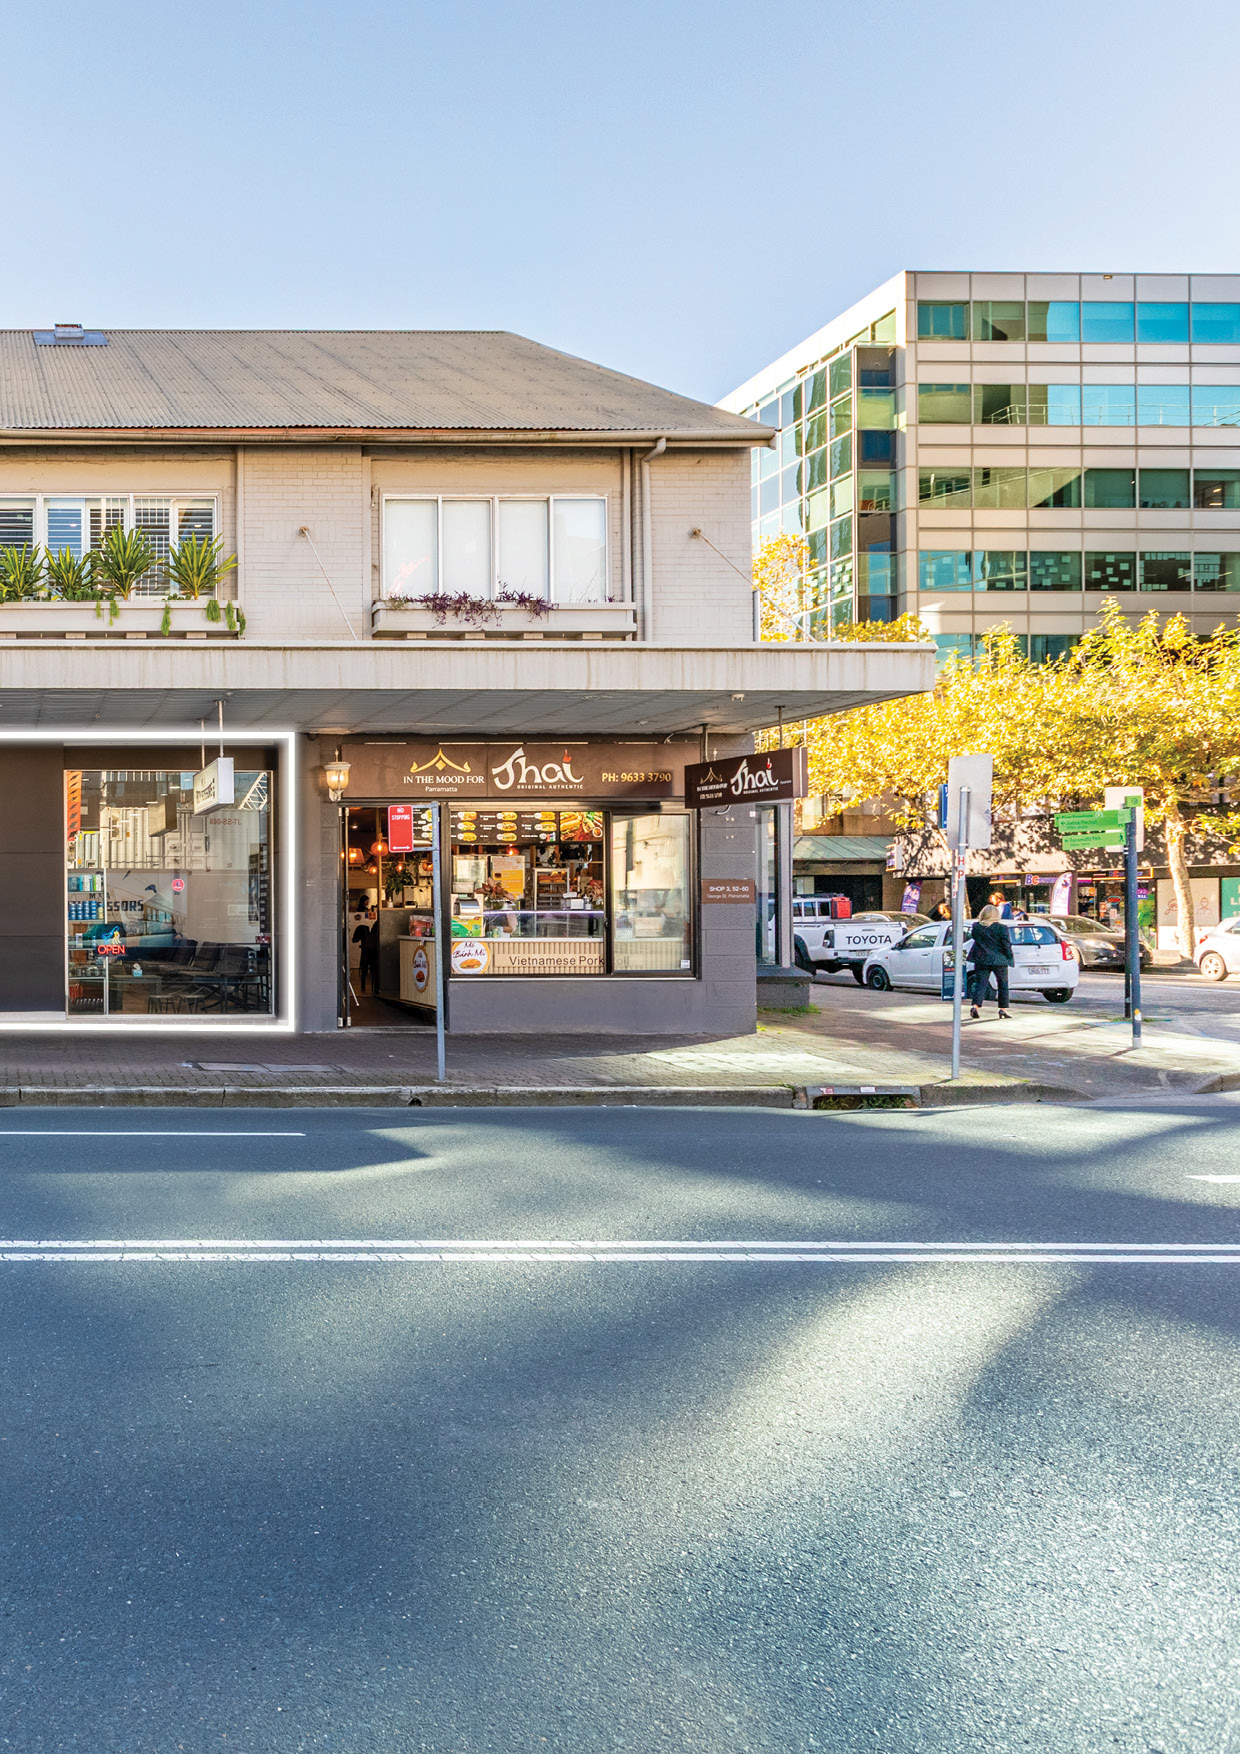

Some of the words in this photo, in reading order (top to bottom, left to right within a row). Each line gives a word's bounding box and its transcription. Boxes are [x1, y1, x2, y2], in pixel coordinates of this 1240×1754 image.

[492, 747, 584, 790] Thai
[602, 773, 619, 782] PH:
[621, 773, 645, 782] 9633
[648, 773, 671, 782] 3790
[731, 759, 778, 795] Thai
[1025, 874, 1039, 885] BC
[107, 900, 144, 911] SSORS
[846, 935, 892, 945] TOYOTA
[98, 945, 126, 954] OPEN
[509, 956, 576, 966] Vietnamese
[579, 956, 604, 966] Pork
[616, 956, 629, 966] oll
